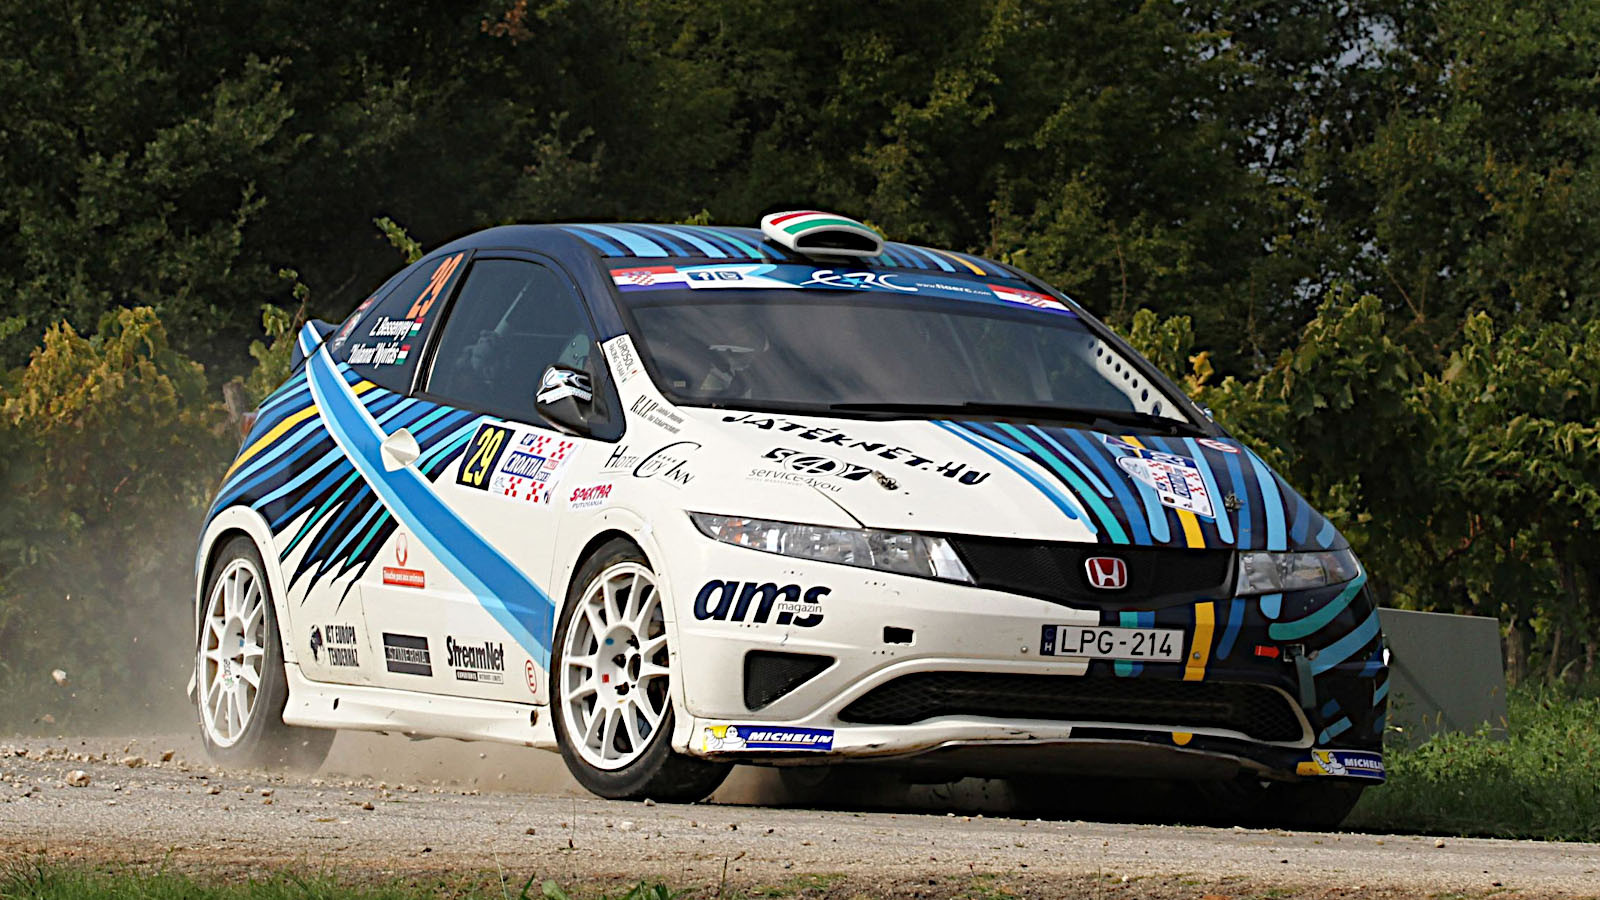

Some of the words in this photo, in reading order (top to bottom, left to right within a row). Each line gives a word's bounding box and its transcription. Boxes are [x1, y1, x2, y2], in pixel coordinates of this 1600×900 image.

[406, 252, 464, 319] 29
[616, 337, 634, 371] EUROSOL
[462, 427, 505, 486] 29
[502, 453, 544, 478] CROATIA
[693, 579, 832, 628] ams
[777, 601, 823, 614] magazin
[447, 635, 504, 671] StreamNet
[1061, 629, 1172, 657] LPG-214
[748, 732, 833, 743] MICHELIN
